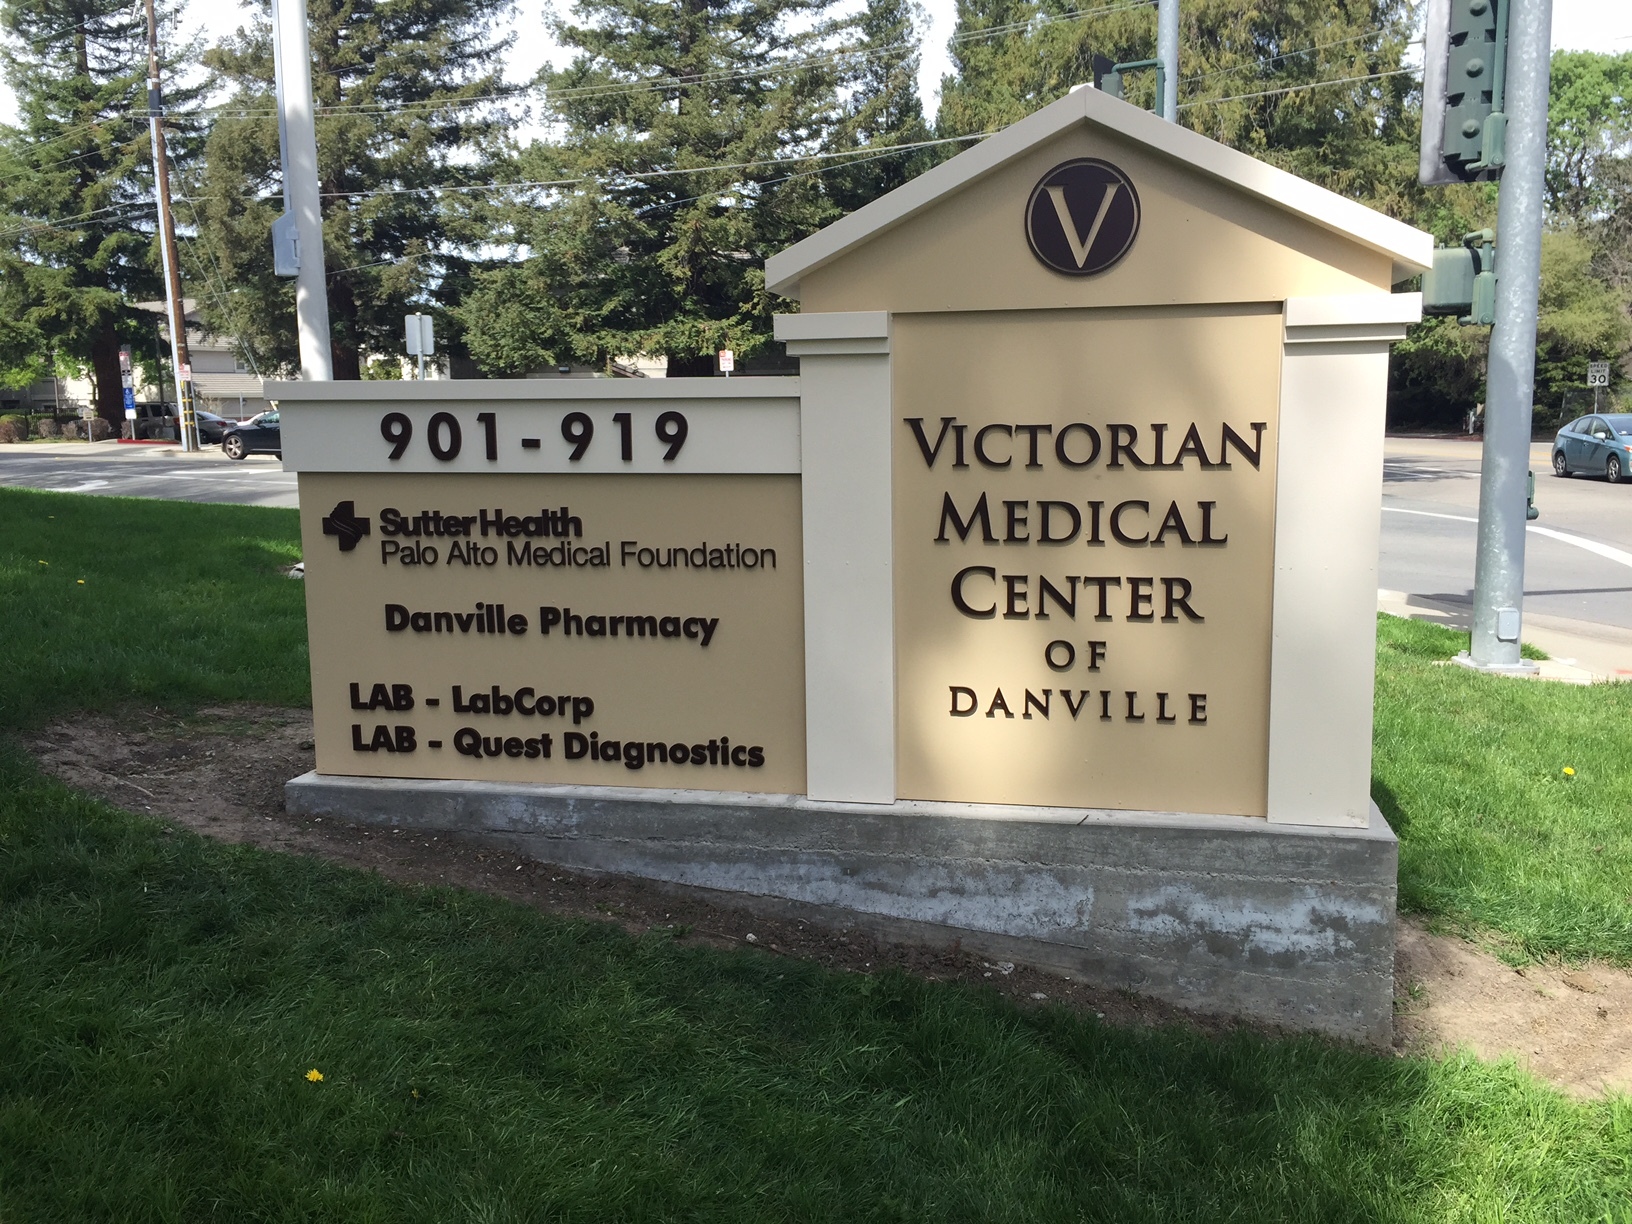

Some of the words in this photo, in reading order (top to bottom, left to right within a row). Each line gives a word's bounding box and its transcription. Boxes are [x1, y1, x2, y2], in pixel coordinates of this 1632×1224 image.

[1043, 181, 1123, 269] V
[1590, 374, 1606, 384] 30
[903, 416, 1268, 470] VICTORIAN
[933, 490, 1229, 546] MEDICAL
[381, 540, 439, 567] Palo
[446, 540, 499, 567] Alto
[506, 541, 611, 569] Medical
[620, 541, 777, 570] Foundation
[950, 565, 1205, 622] CENTER
[384, 601, 529, 636] Danville
[539, 606, 720, 648] Pharmacy
[1044, 639, 1107, 672] OF
[349, 682, 415, 712] LAB
[452, 684, 595, 725] LabCorp
[949, 686, 1208, 725] DANVILLE
[351, 723, 418, 754] LAB
[453, 726, 553, 760] Quest
[563, 730, 766, 770] Diagnostics
